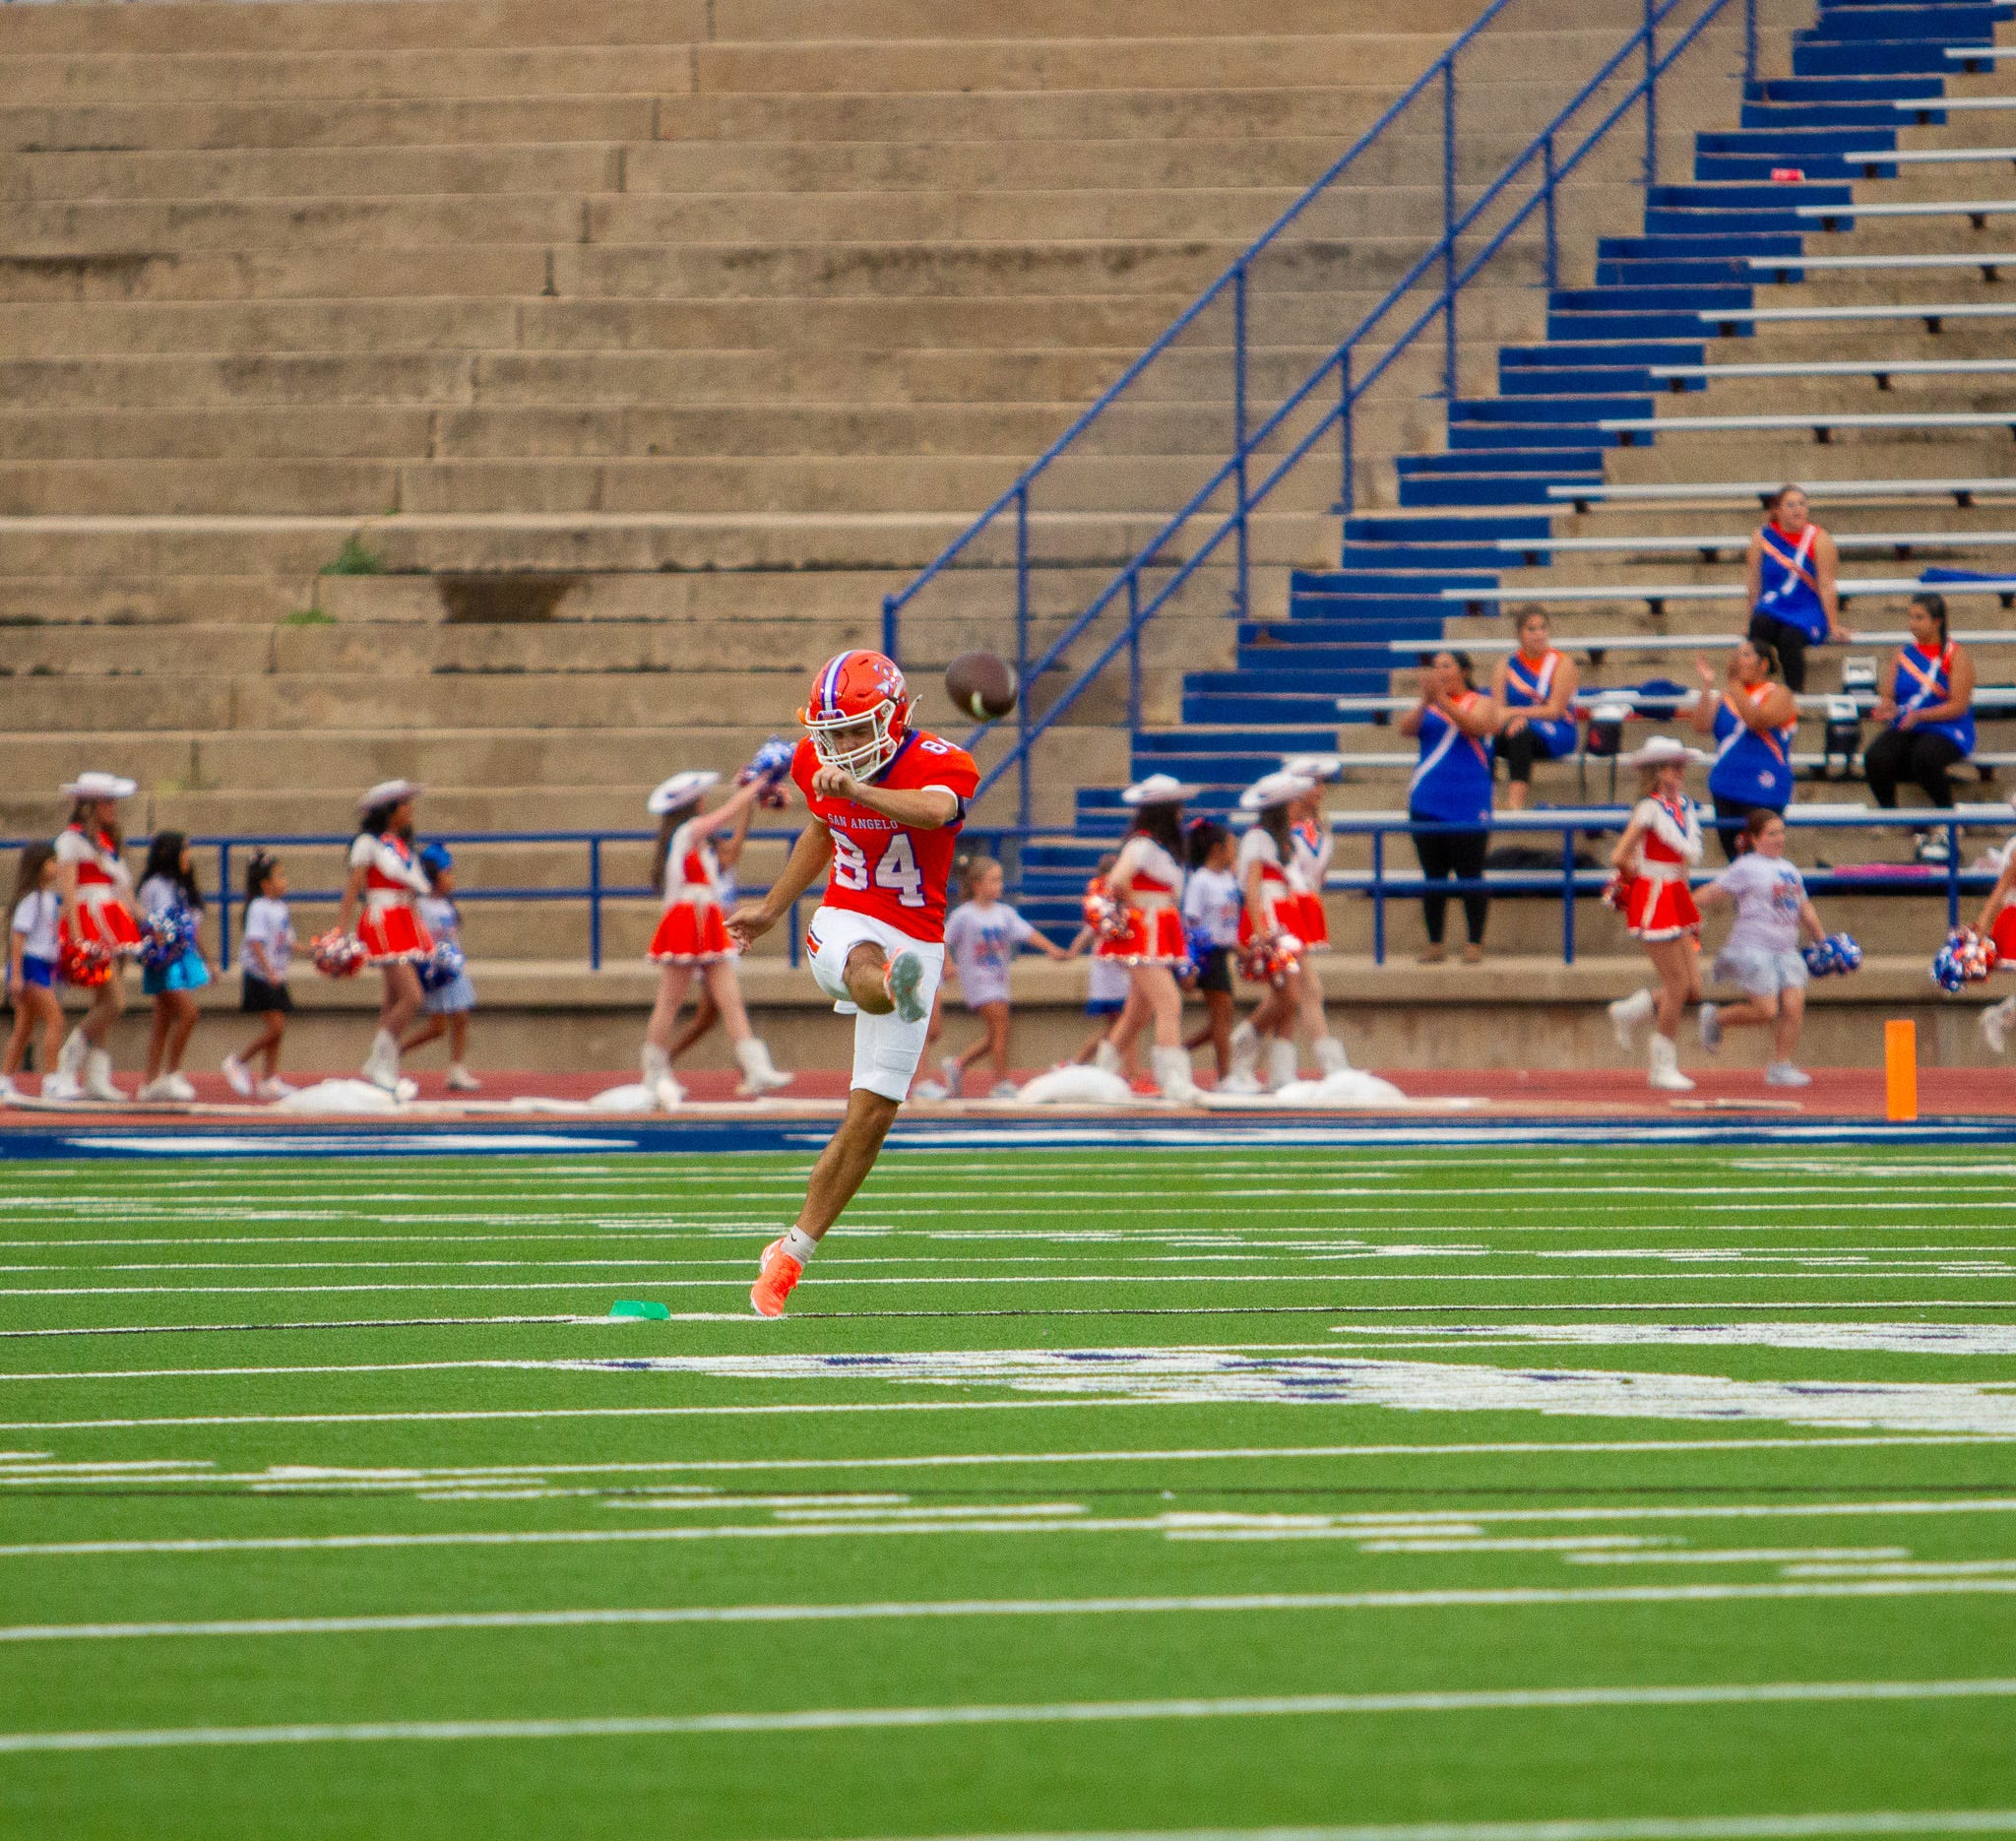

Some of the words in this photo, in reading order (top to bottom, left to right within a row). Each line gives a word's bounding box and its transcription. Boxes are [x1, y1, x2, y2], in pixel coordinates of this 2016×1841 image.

[827, 812, 847, 827] SAN
[850, 818, 898, 830] ANGELO
[829, 827, 927, 907] 84
